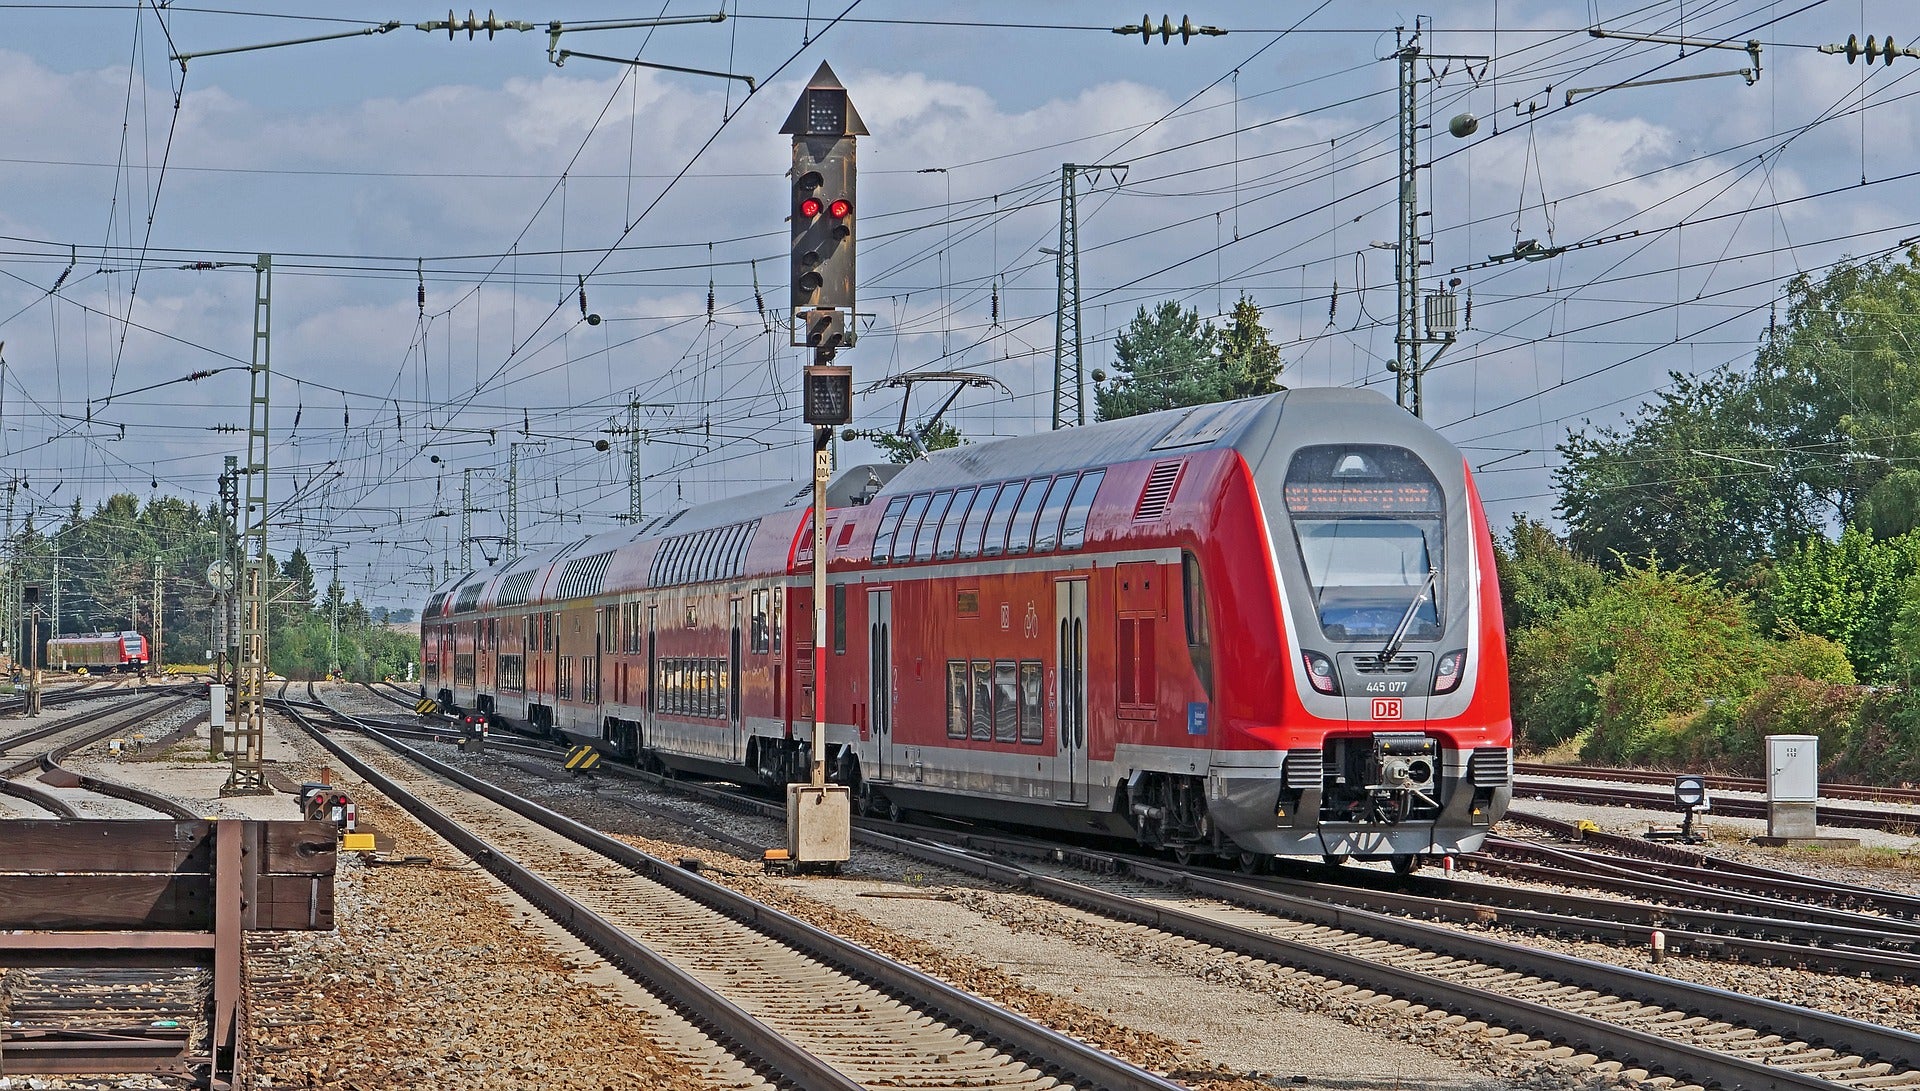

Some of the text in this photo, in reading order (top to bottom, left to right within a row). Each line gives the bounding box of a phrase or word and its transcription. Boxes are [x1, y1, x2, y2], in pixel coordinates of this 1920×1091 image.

[819, 454, 827, 465] N
[1366, 681, 1407, 692] 445 077
[1374, 700, 1400, 718] DB
